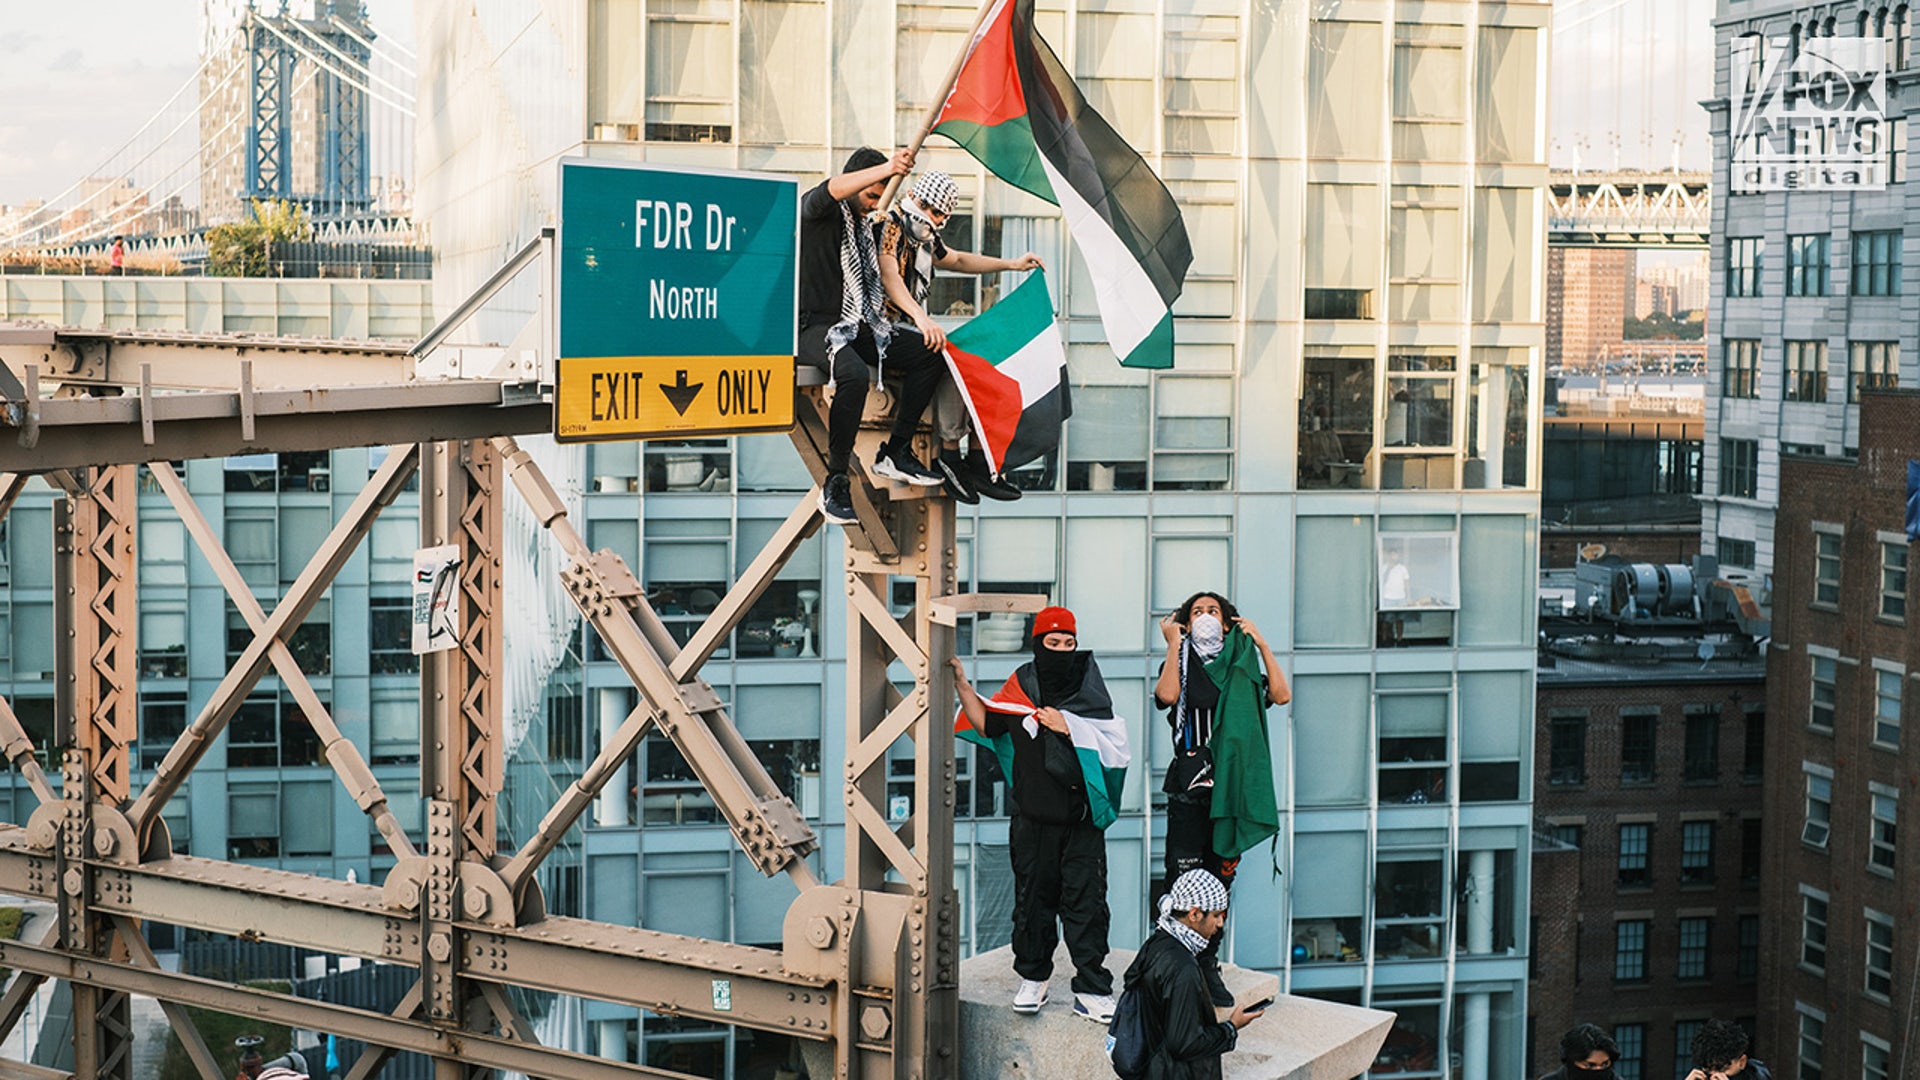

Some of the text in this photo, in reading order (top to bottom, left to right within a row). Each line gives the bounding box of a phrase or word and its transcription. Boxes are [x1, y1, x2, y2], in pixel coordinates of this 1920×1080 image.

[635, 199, 736, 251] FDR Dr
[650, 279, 717, 319] NORTH
[591, 369, 771, 421] EXIT ONLY
